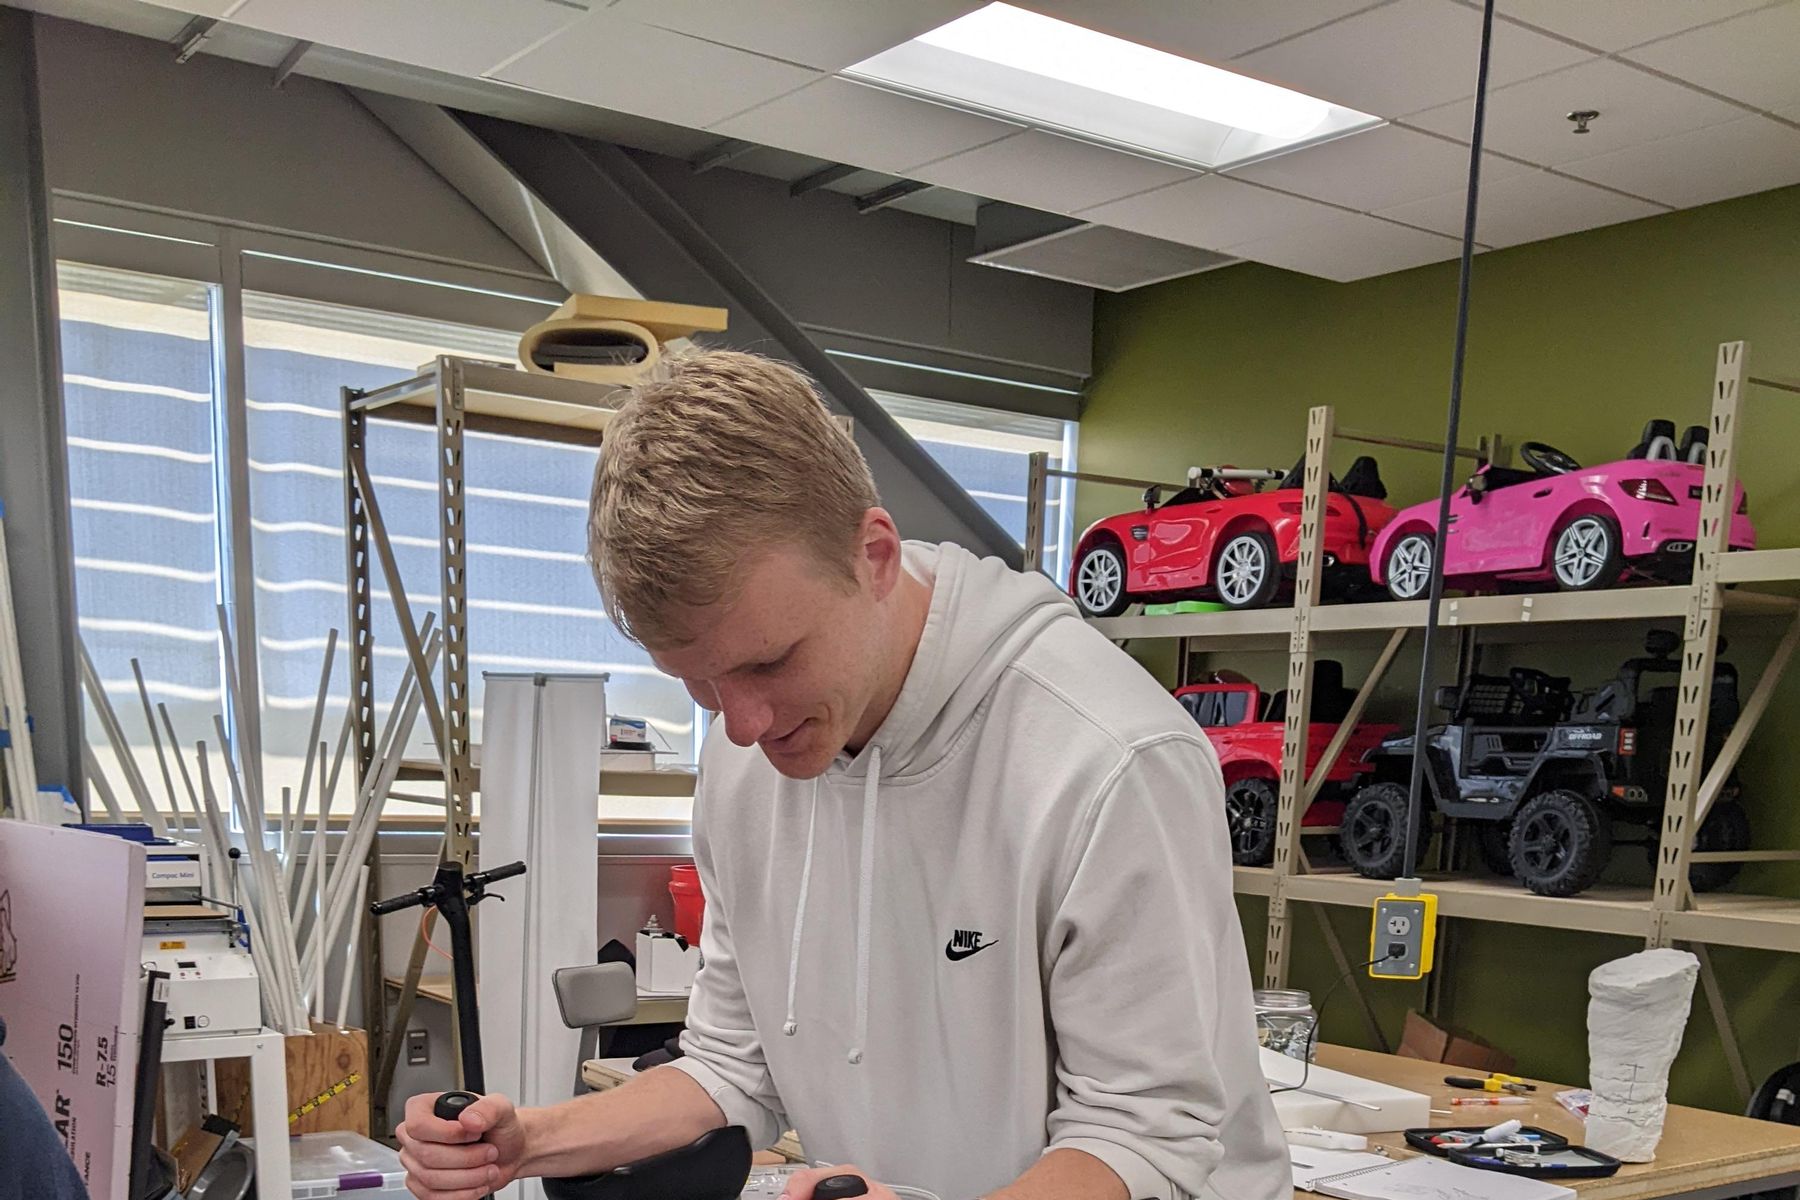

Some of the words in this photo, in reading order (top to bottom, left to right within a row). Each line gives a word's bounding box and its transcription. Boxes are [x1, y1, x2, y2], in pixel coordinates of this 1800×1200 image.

[152, 872, 178, 880] Compac
[953, 930, 983, 949] NIKE
[57, 1023, 74, 1071] 150
